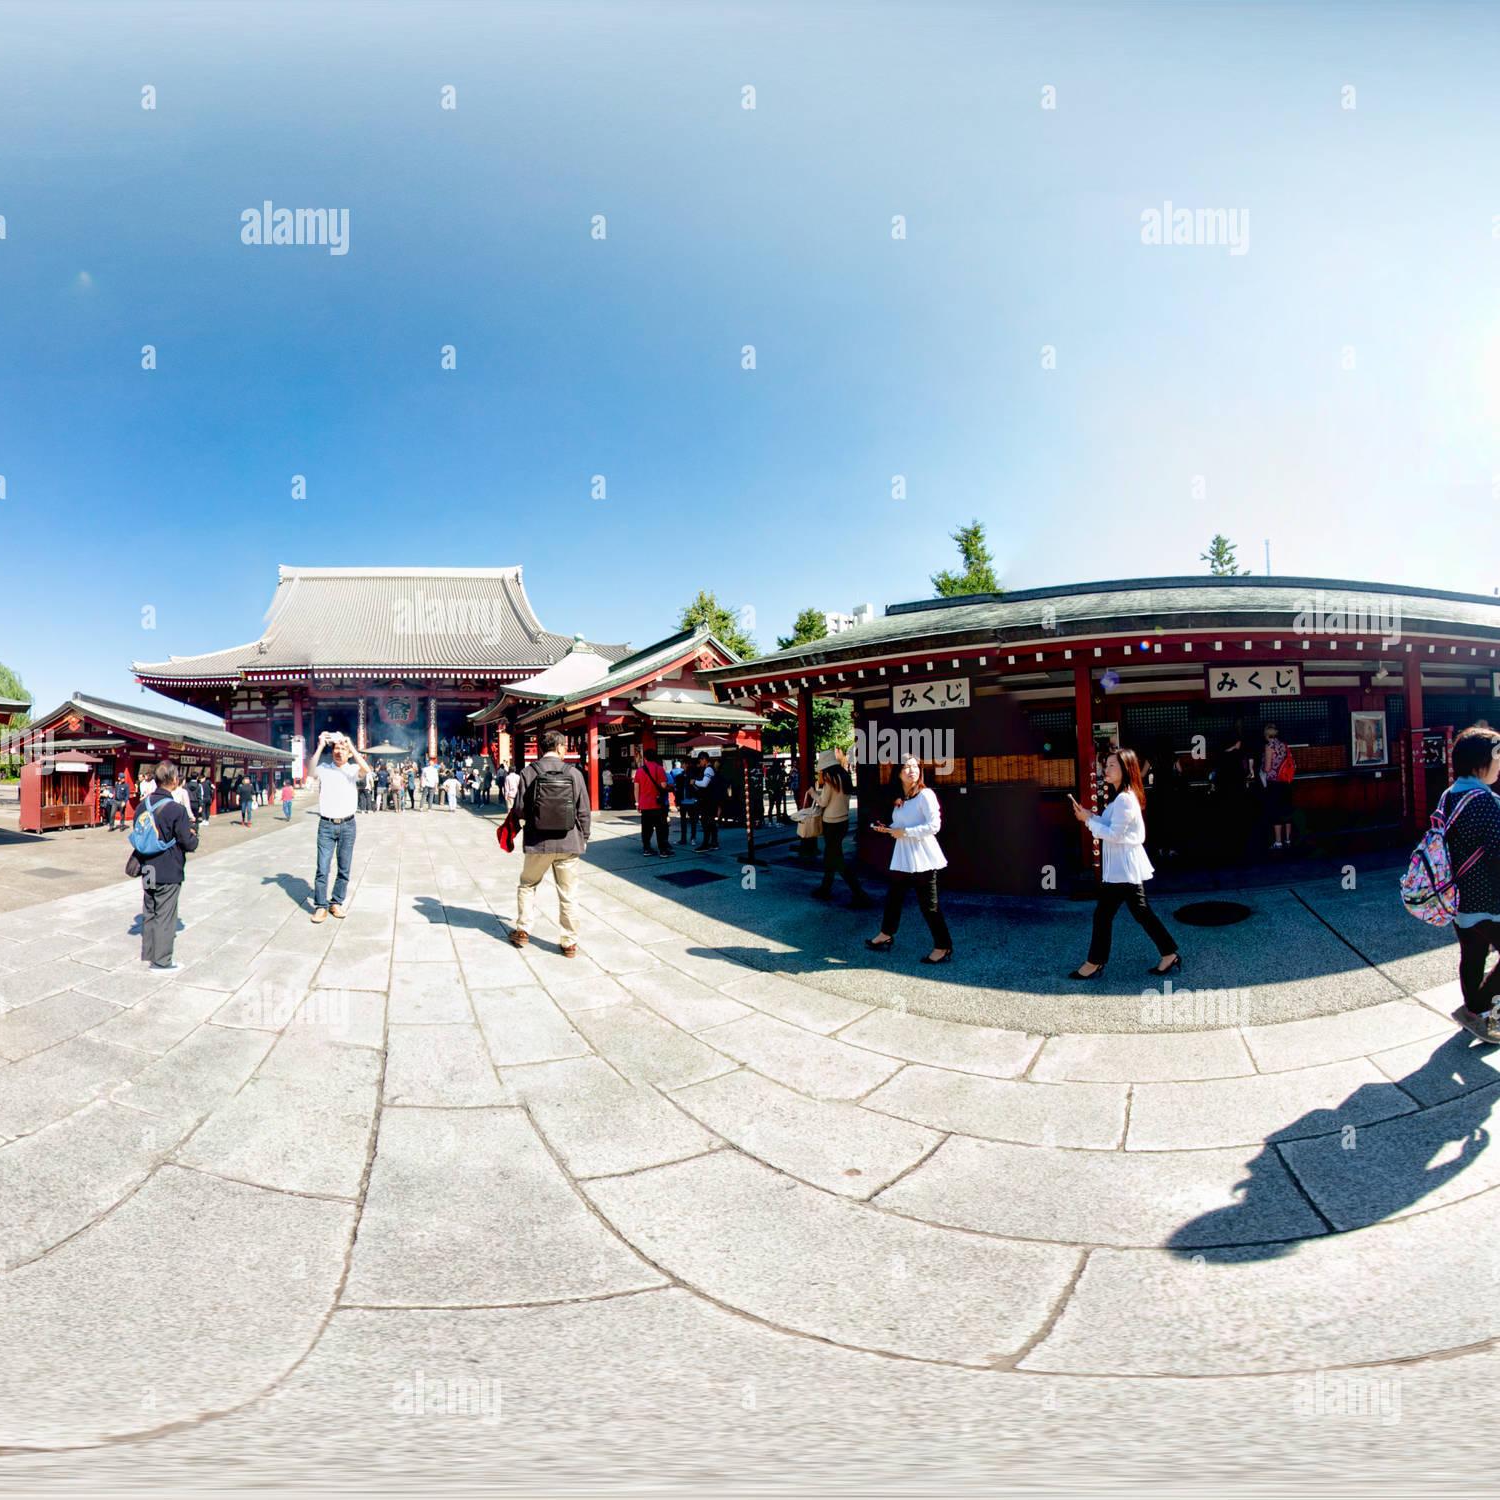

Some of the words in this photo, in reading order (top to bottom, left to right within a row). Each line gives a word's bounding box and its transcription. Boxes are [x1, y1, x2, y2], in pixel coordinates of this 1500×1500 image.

[1216, 670, 1294, 692] みくじ
[899, 683, 962, 708] みくじ
